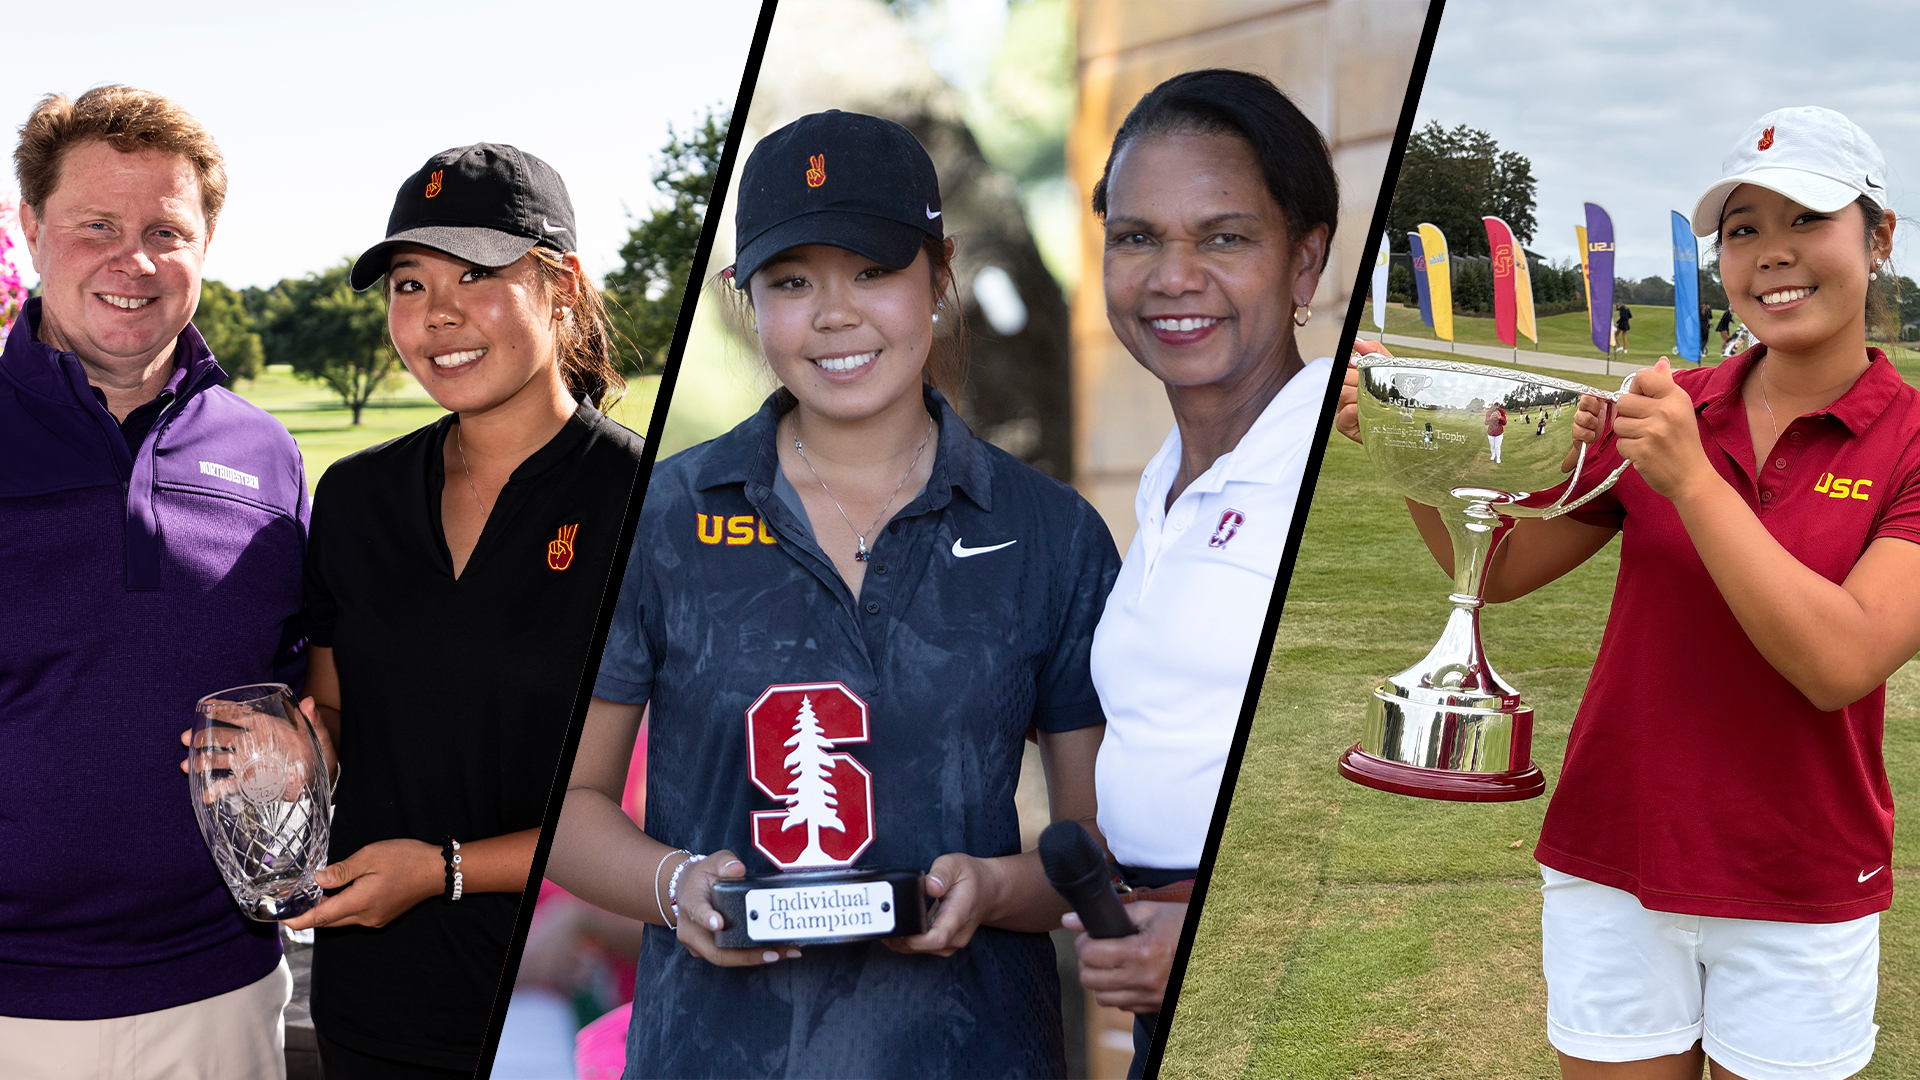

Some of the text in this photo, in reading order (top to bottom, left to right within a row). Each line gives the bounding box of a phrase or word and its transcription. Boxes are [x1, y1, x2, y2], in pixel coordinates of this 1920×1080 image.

[1435, 429, 1468, 444] Trophy
[199, 460, 259, 490] NORTHWESTERN
[1814, 472, 1873, 501] USC
[769, 887, 870, 912] Individual
[769, 908, 873, 932] Champion
